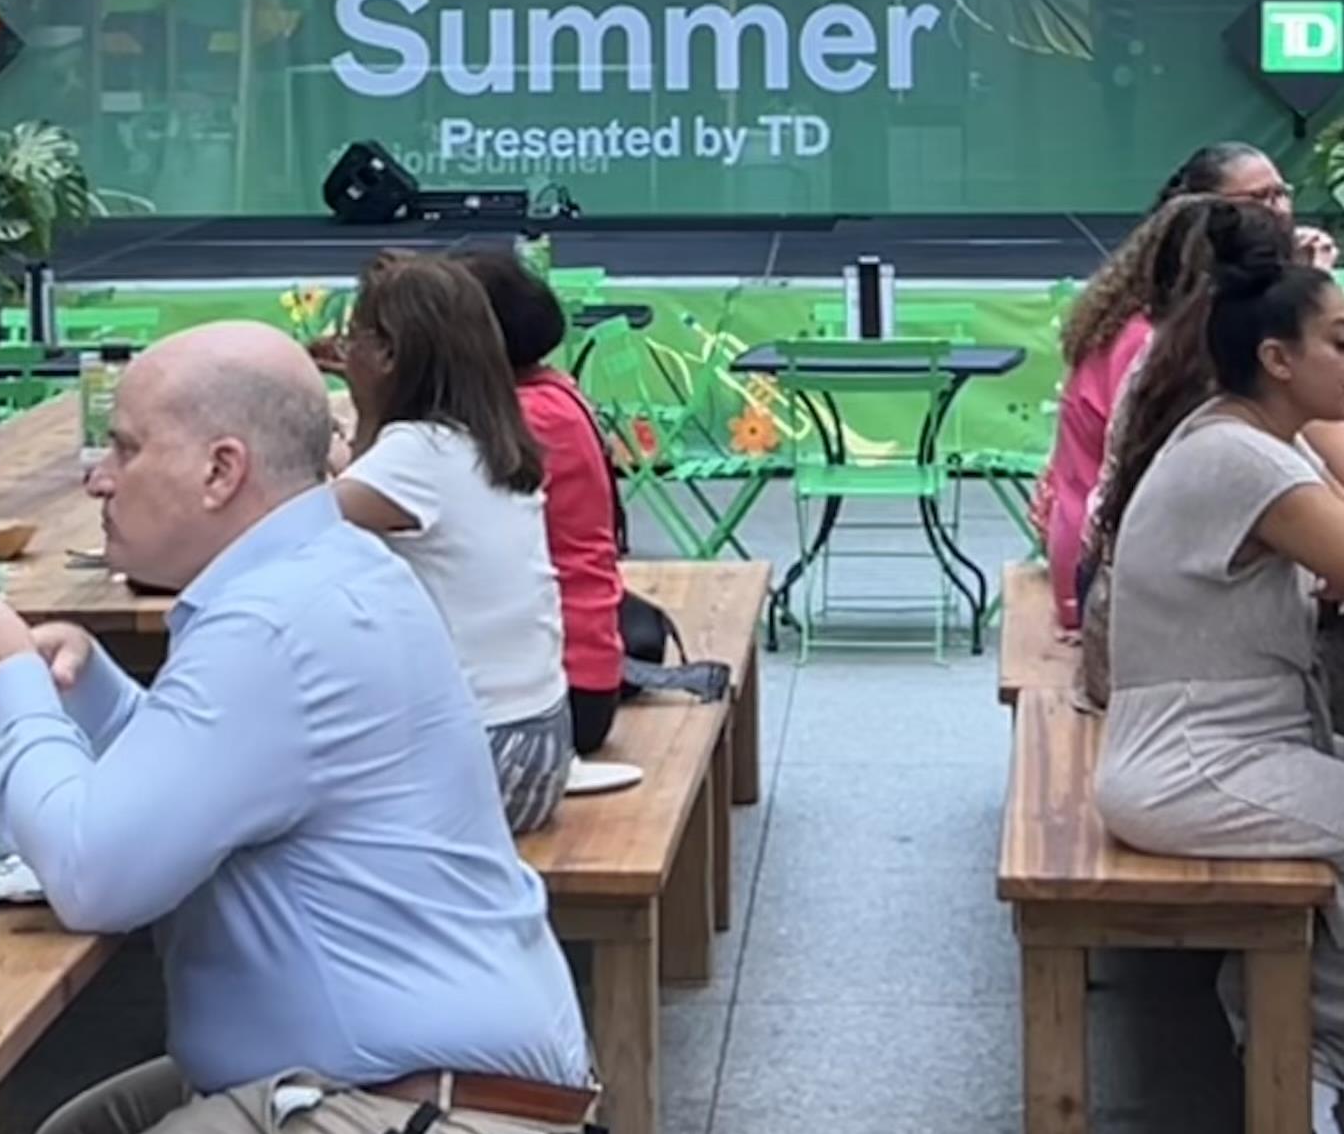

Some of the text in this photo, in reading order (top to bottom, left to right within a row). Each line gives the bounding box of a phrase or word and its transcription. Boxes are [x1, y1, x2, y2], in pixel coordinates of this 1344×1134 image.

[1270, 12, 1337, 58] TD
[440, 115, 830, 165] Presented by TD
